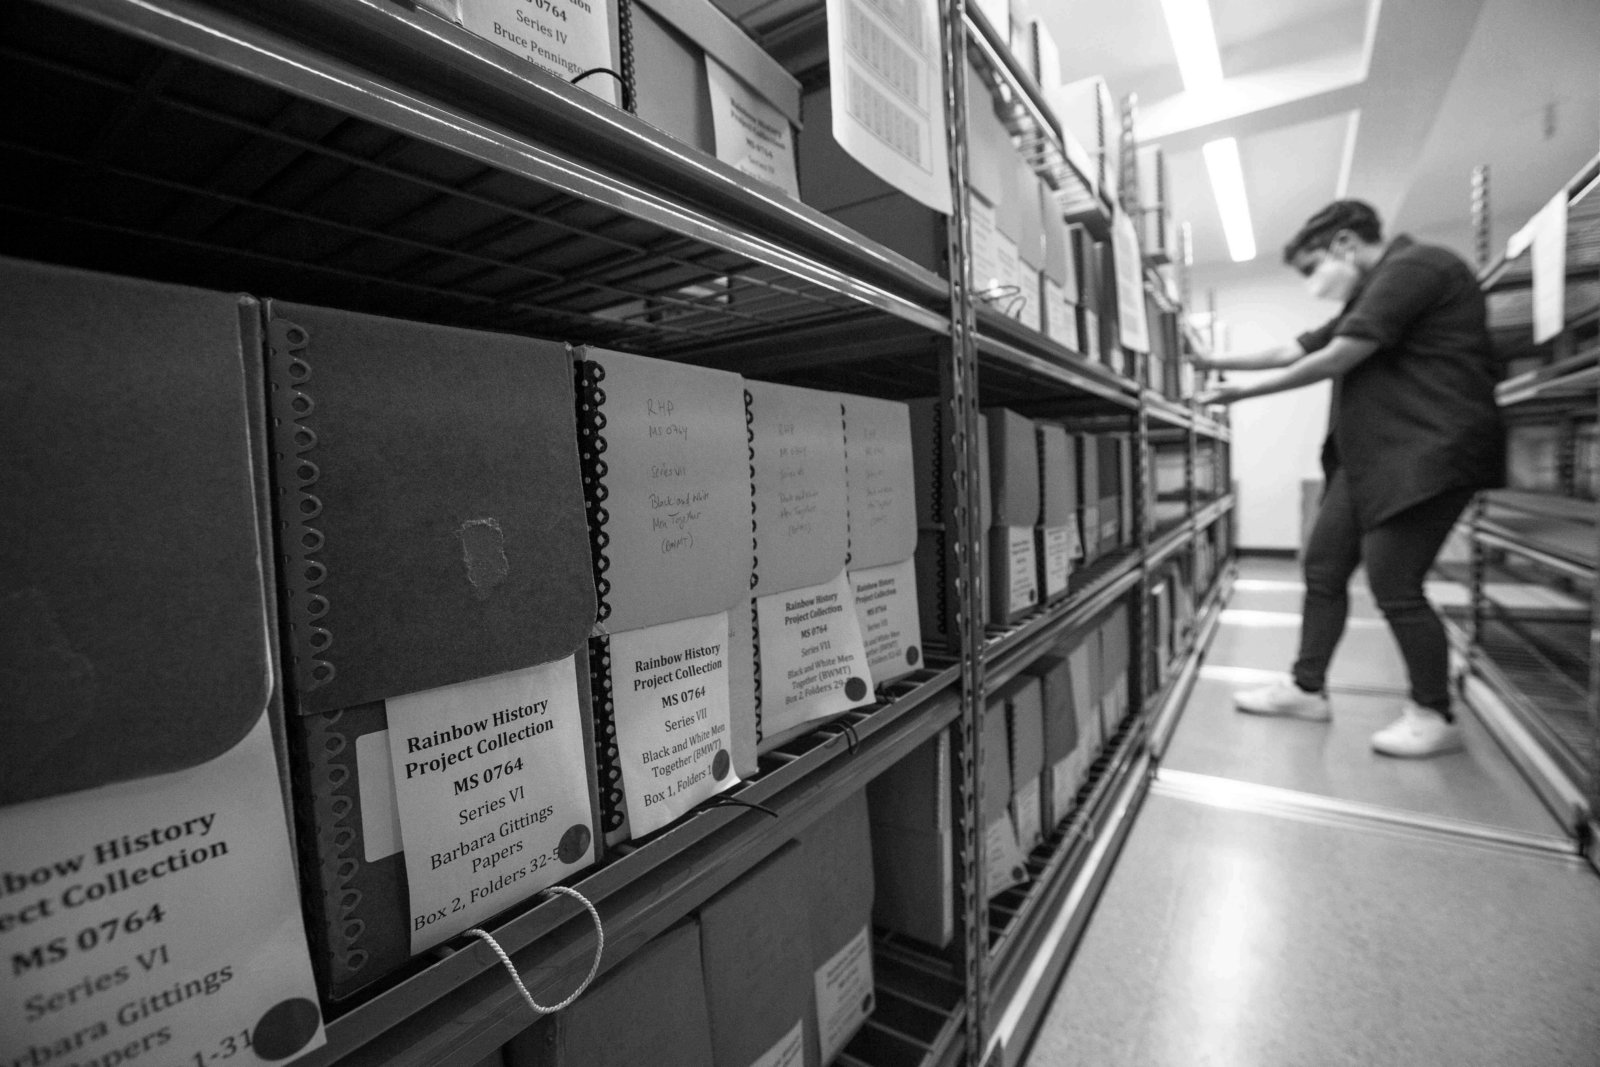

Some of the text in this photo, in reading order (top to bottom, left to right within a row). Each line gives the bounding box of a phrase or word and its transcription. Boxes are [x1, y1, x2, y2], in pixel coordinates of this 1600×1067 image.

[536, 0, 567, 22] 0764
[493, 22, 527, 48] Bruce
[516, 9, 568, 44] Series IV
[647, 398, 674, 416] RHP
[649, 425, 662, 438] MS
[676, 493, 690, 506] and
[785, 605, 843, 626] Project Collection
[786, 593, 838, 612] Rainbow History
[801, 624, 828, 640] MS 0764
[635, 644, 720, 673] Rainbow History
[787, 654, 854, 679] Black and White Men
[801, 646, 819, 658] Series
[634, 660, 722, 692] Project Collection
[792, 676, 818, 690] Together
[661, 686, 706, 708] MS 0764
[786, 696, 798, 705] Box
[804, 684, 832, 697] Folders
[407, 700, 548, 754] Rainbow History
[664, 708, 707, 732] Series VII
[404, 719, 554, 780] Project Collection
[642, 724, 726, 764] Black and White Men
[453, 757, 524, 796] MS 0764
[652, 756, 692, 778] Together
[644, 791, 666, 808] Box
[667, 785, 676, 797] 1,
[677, 770, 706, 792] Folders
[458, 786, 525, 826] Series VI
[430, 804, 554, 871] Barbara Gittings
[1, 812, 216, 896] bow History
[472, 840, 524, 874] Papers
[61, 841, 230, 909] Collection
[414, 844, 567, 932] Box 2, Folders 32-5
[11, 902, 167, 978] MS 0764
[24, 944, 170, 1023] Series VI
[116, 965, 234, 1027] Gittings
